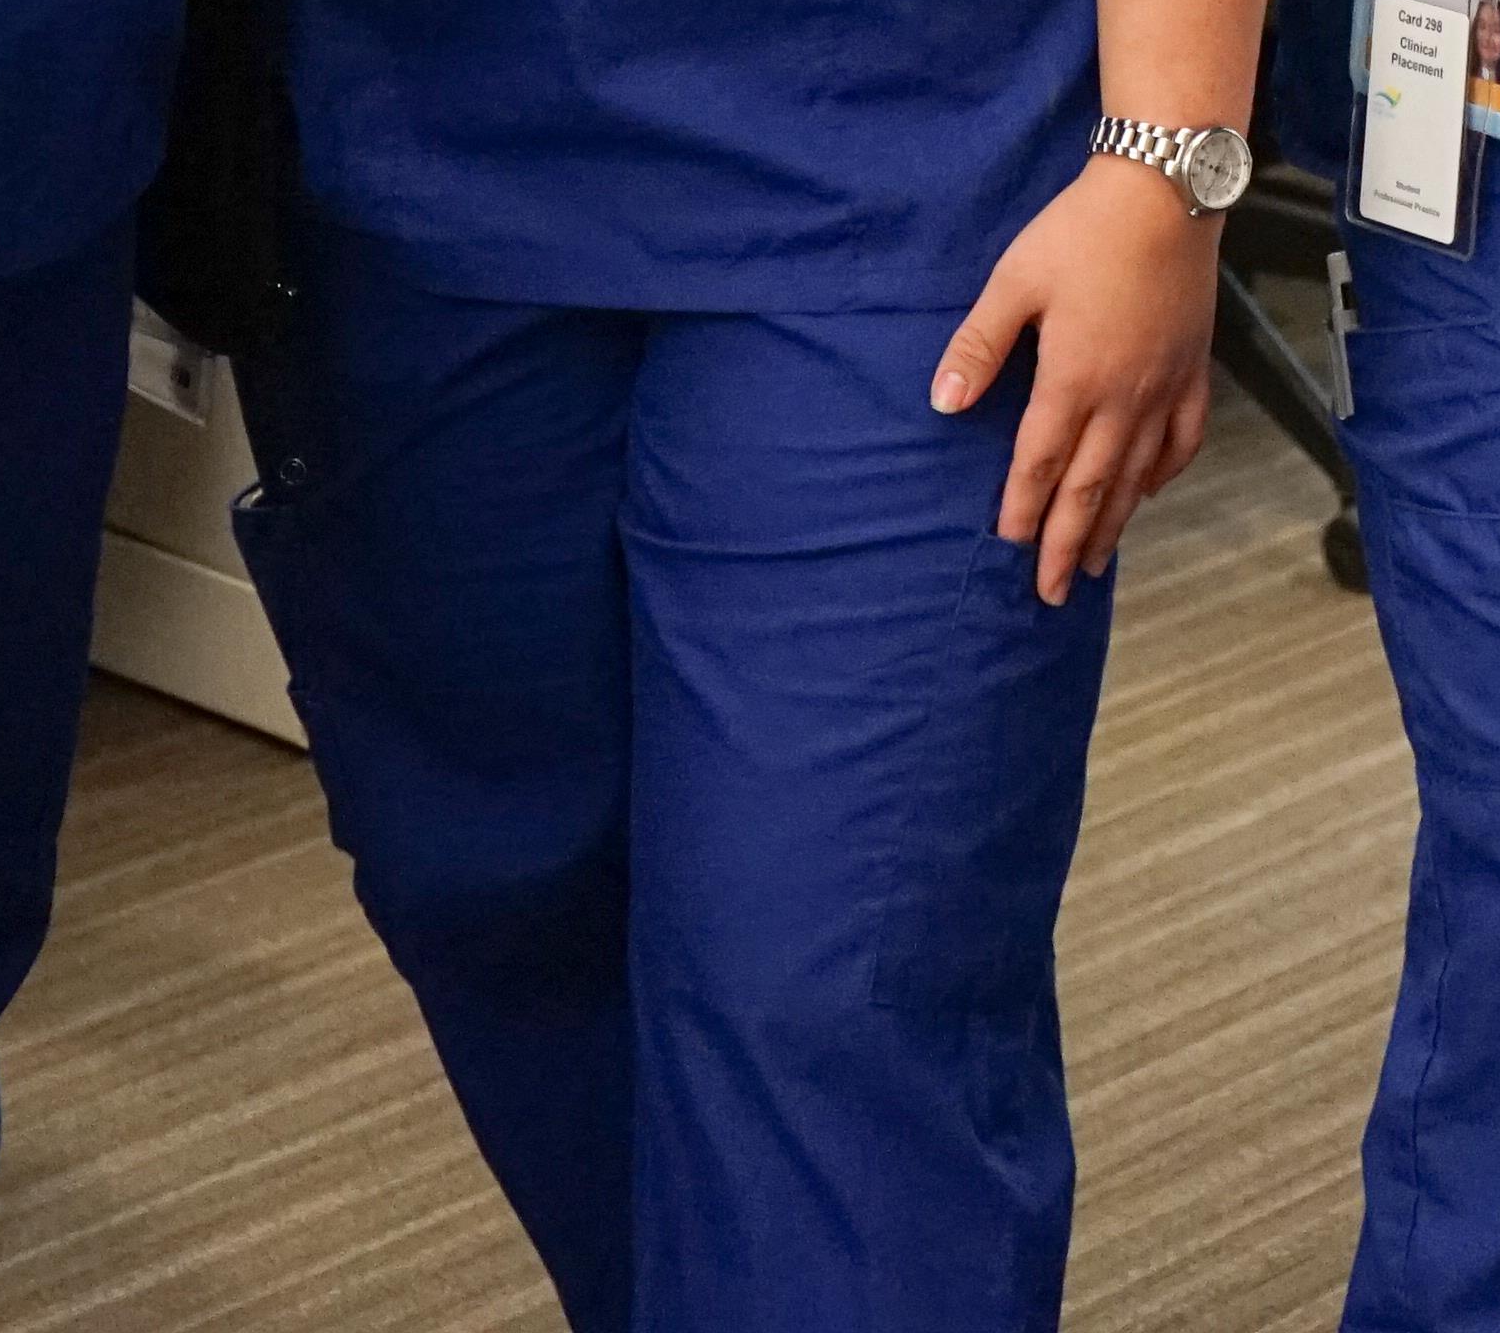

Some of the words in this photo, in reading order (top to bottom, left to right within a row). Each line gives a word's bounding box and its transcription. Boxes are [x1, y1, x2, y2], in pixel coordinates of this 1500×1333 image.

[1398, 9, 1423, 28] Card
[1425, 17, 1443, 34] 298
[1400, 36, 1438, 59] Clinical
[1391, 52, 1444, 80] Placement
